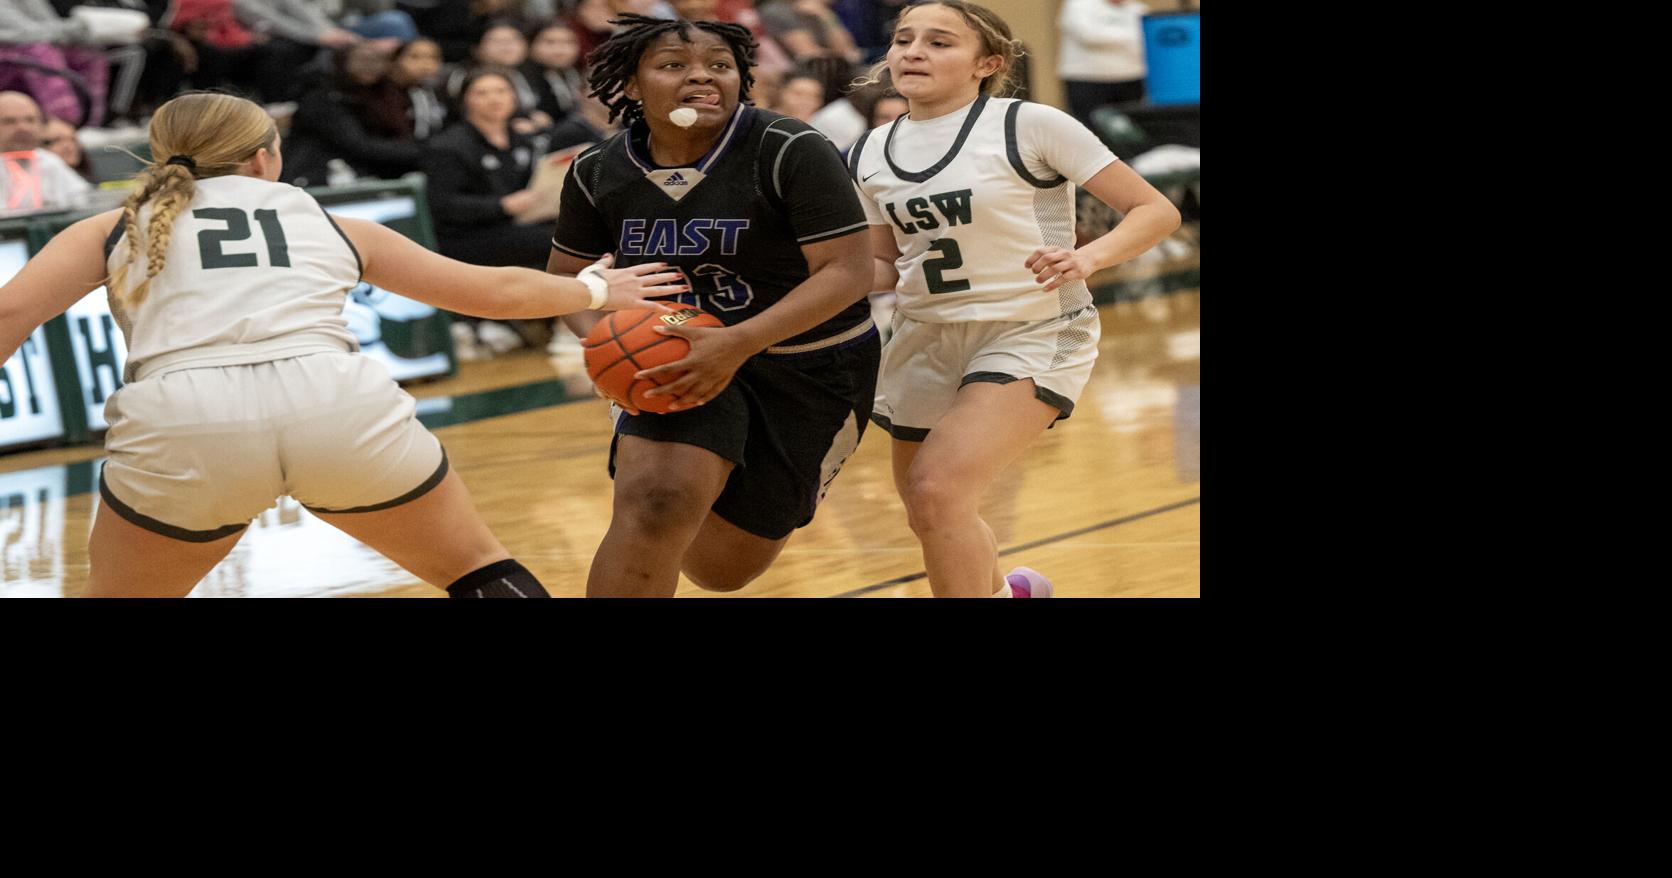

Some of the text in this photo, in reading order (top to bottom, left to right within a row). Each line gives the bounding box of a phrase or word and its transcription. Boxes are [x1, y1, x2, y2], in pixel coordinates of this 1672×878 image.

[619, 218, 750, 256] EAST
[884, 187, 973, 235] LSW
[192, 207, 291, 269] 21
[922, 238, 971, 294] 2
